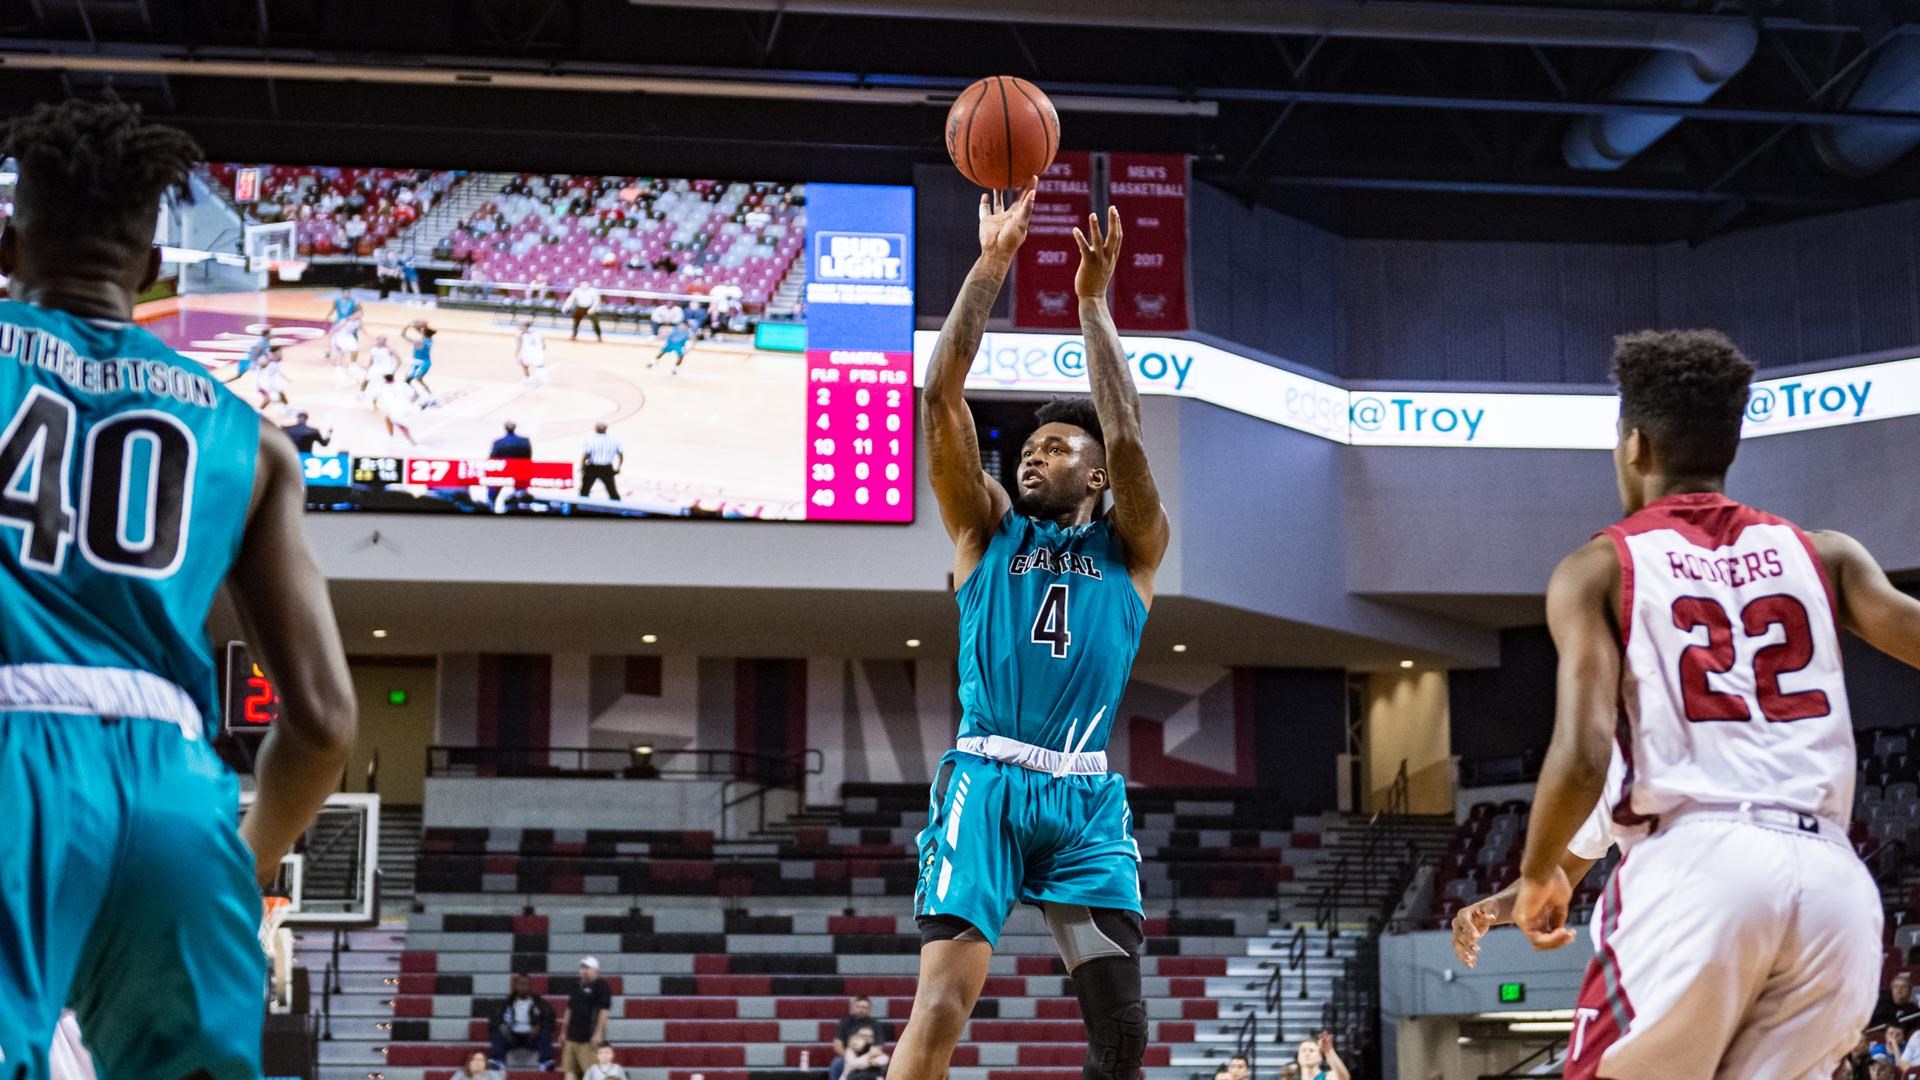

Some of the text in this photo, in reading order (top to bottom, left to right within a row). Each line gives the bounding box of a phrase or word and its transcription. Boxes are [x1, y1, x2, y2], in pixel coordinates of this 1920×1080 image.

[1127, 165, 1167, 180] MEN'S
[1036, 180, 1089, 194] KETBALL
[1110, 181, 1185, 197] BASKETBALL
[831, 236, 891, 257] BUD
[820, 255, 901, 280] LIGHT
[1037, 251, 1068, 265] 2017
[1133, 253, 1164, 267] 2017
[816, 388, 900, 408] 2 0 2
[816, 413, 900, 432] 4 3 0
[813, 438, 899, 456] 10 11 1
[304, 457, 343, 480] 34
[411, 460, 450, 482] 27
[855, 462, 869, 480] 0
[885, 463, 899, 481] 0
[0, 384, 198, 580] 40
[1031, 584, 1071, 658] 4
[1671, 594, 1830, 722] 22
